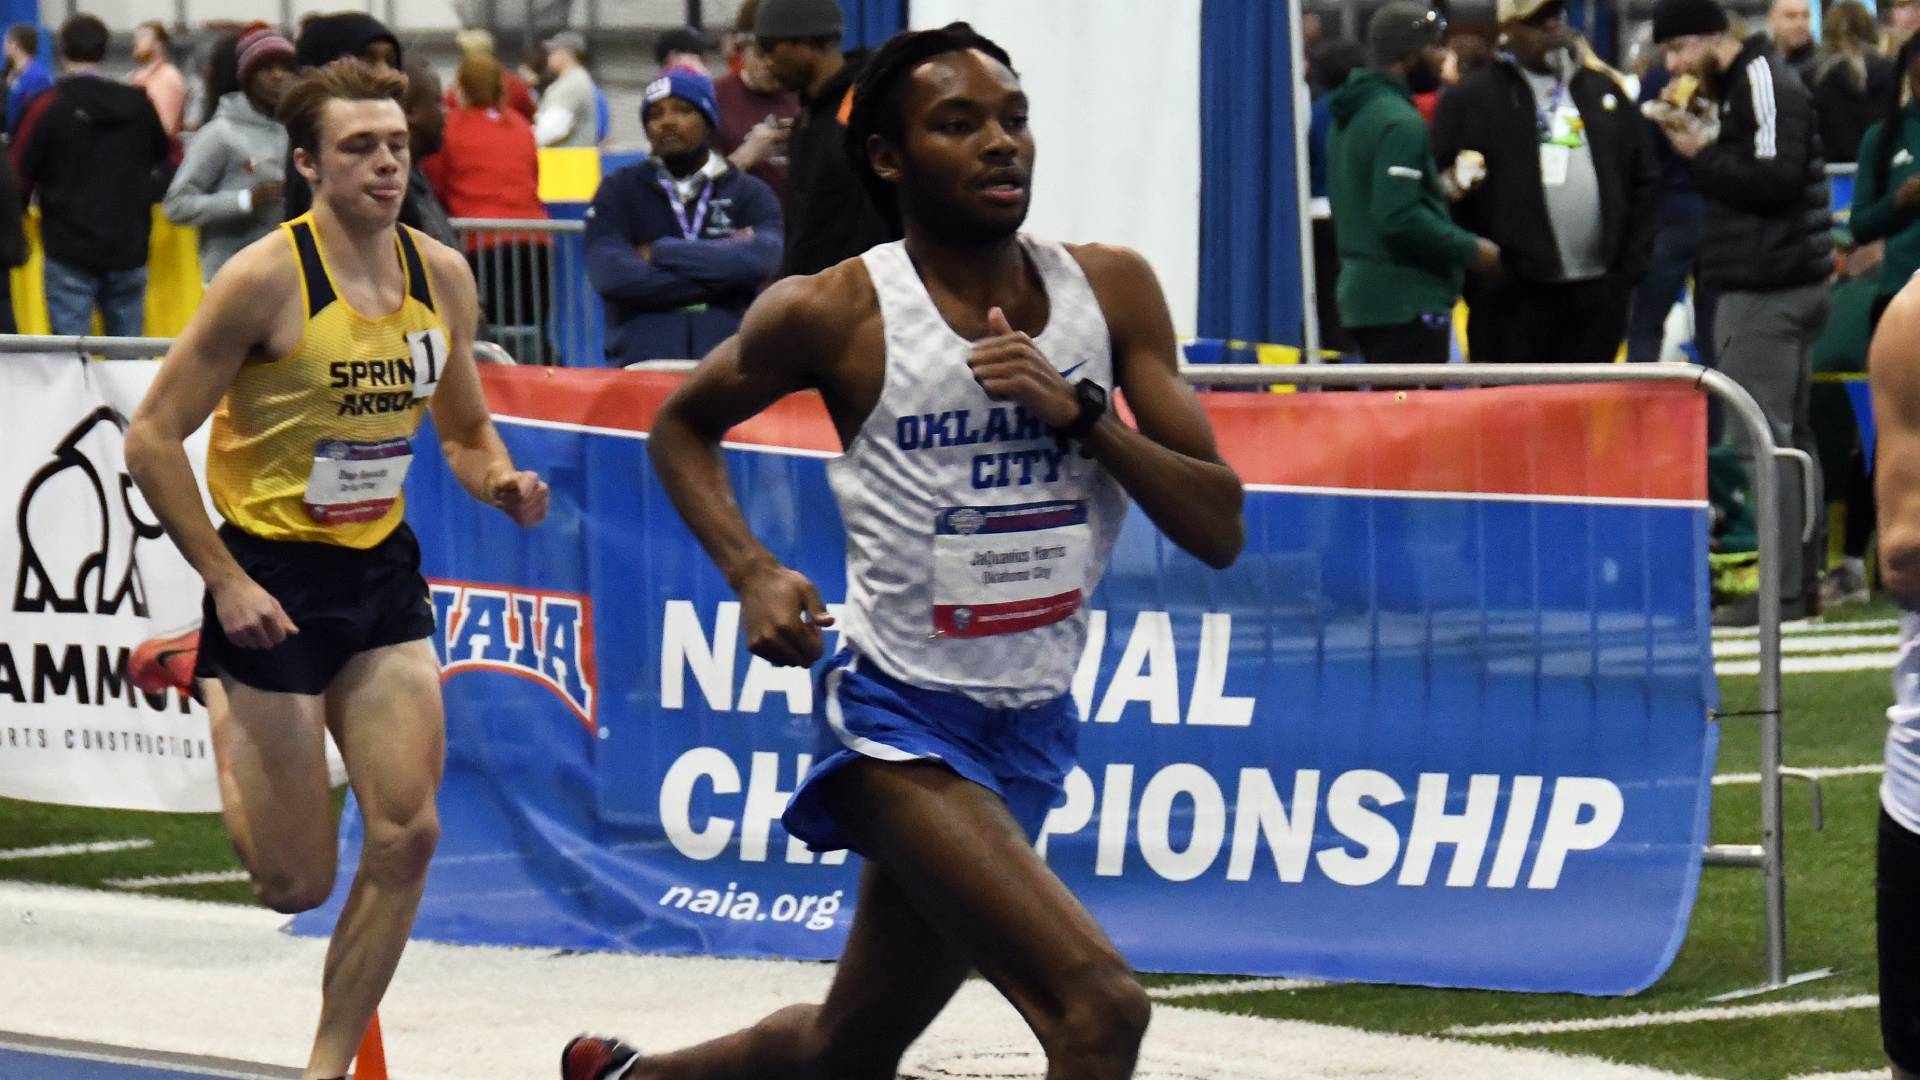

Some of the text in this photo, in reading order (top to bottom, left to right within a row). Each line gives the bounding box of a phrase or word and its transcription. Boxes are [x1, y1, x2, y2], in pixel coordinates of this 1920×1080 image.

[330, 357, 416, 388] SPRIN
[418, 331, 438, 385] 1
[336, 391, 421, 416] ARBO
[897, 406, 1042, 451] OKLAH
[971, 447, 1065, 490] CITY
[660, 600, 1256, 727] NANAL
[0, 727, 205, 760] RTS CONSTRUCTON
[659, 746, 1625, 890] CHPIONSHIP
[659, 882, 843, 931] naia.org
